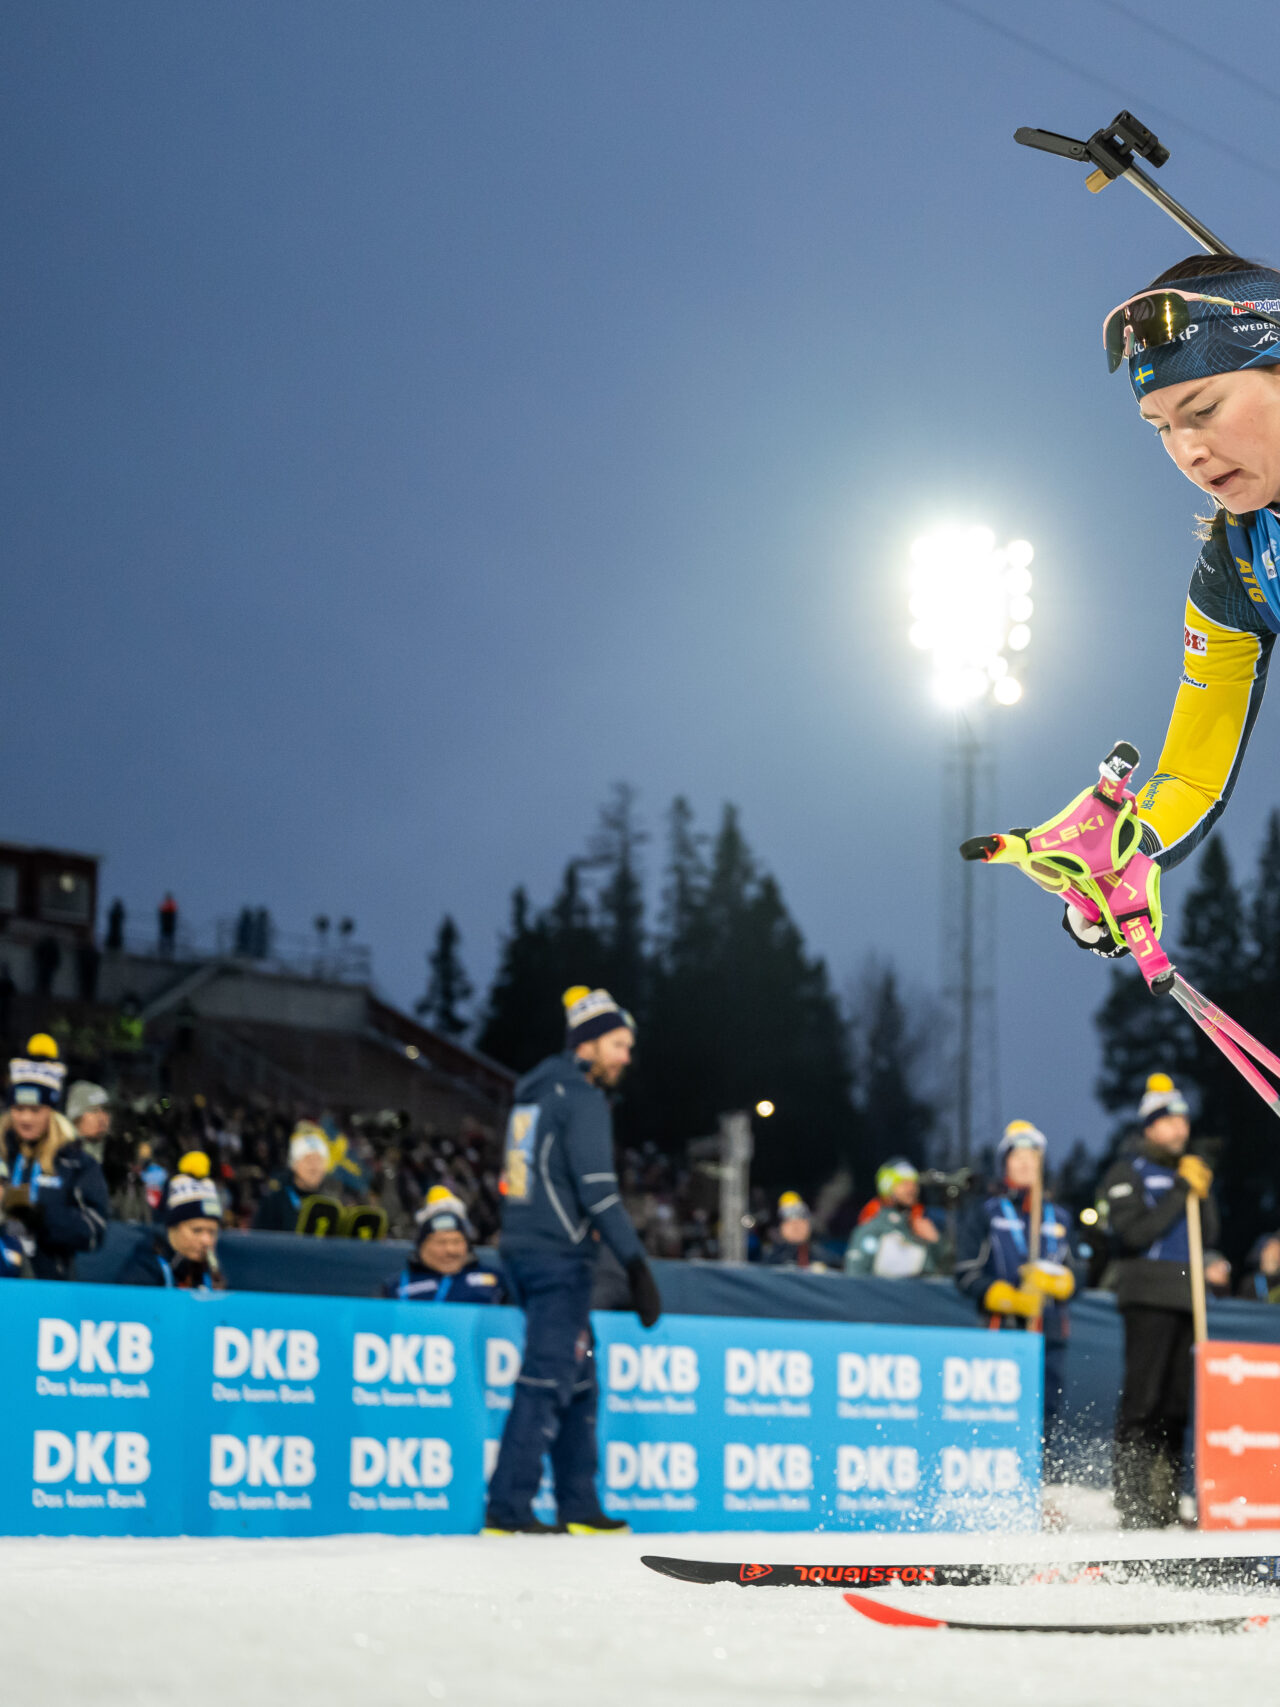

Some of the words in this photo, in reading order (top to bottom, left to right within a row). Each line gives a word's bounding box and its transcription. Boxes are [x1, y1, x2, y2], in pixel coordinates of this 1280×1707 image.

[1235, 556, 1267, 603] ATG
[1041, 815, 1104, 848] LEKI
[1126, 916, 1154, 958] LEK
[37, 1318, 154, 1375] DKB
[213, 1326, 320, 1381] DKB
[352, 1332, 456, 1386] DKB
[608, 1343, 700, 1393] DKB
[724, 1348, 814, 1397] DKB
[837, 1352, 922, 1401] DKB
[942, 1357, 1021, 1403] DKB
[33, 1430, 151, 1485] DKB
[209, 1434, 316, 1487] DKB
[350, 1437, 454, 1488] DKB
[606, 1441, 699, 1491] DKB
[724, 1443, 814, 1491] DKB
[836, 1445, 920, 1491] DKB
[941, 1446, 1021, 1492] DKB
